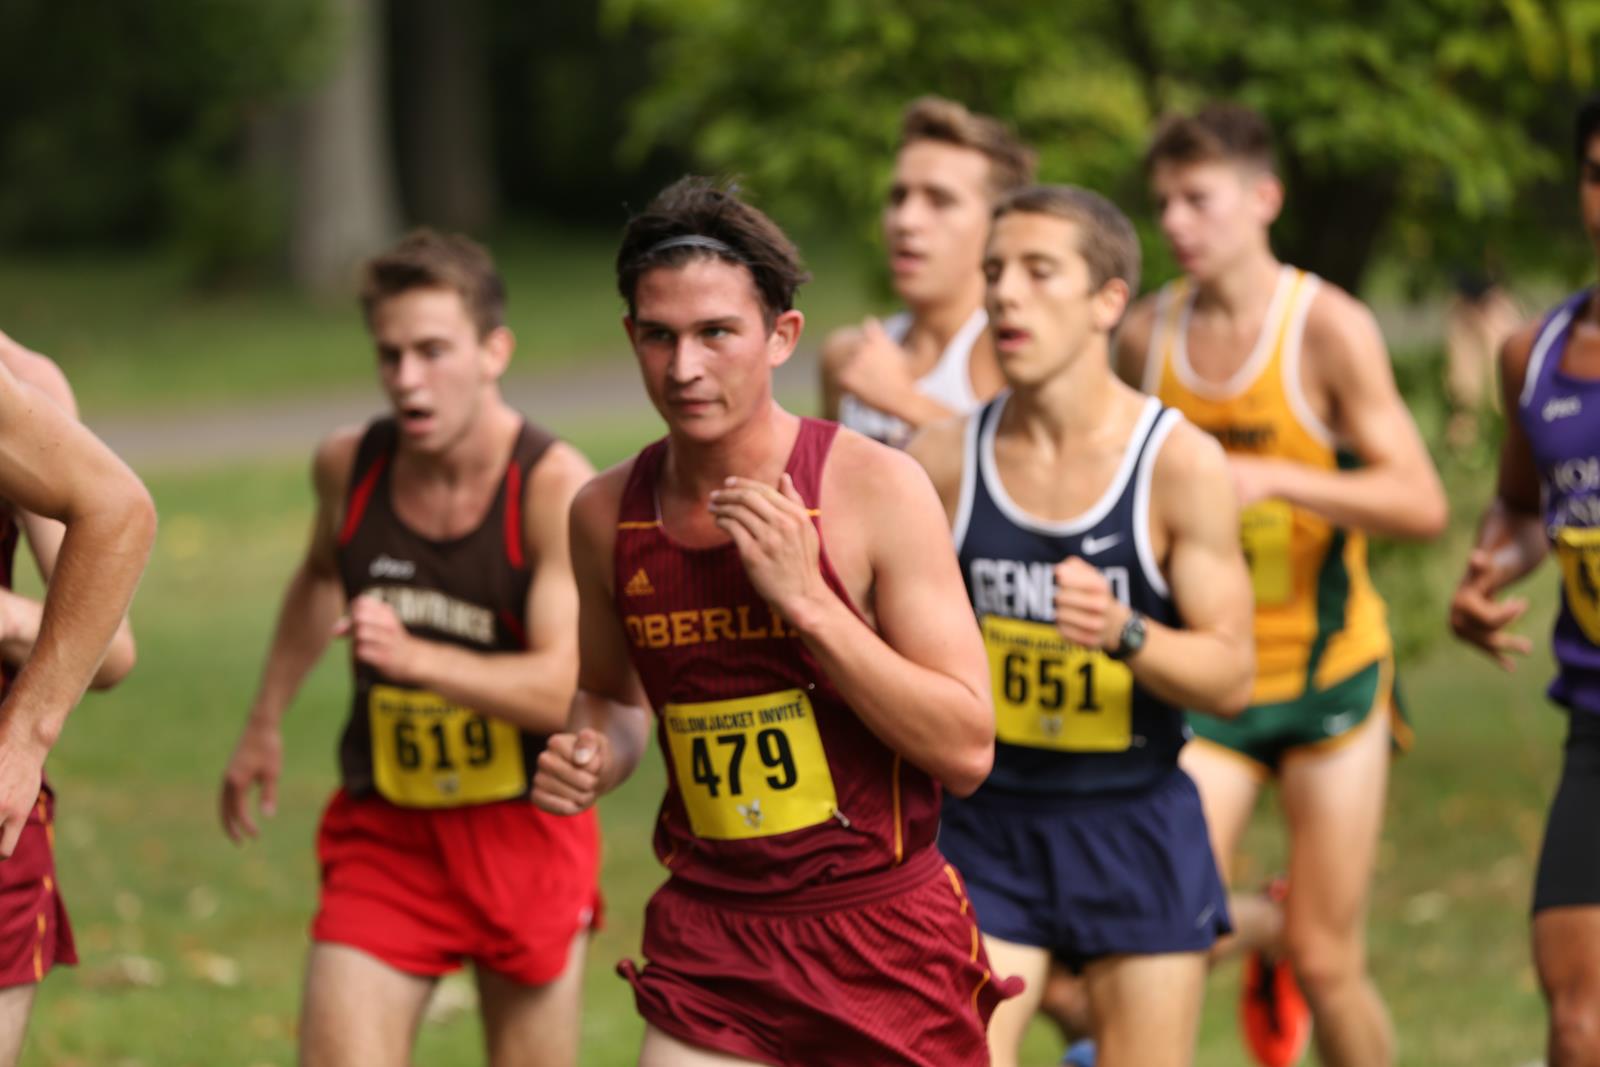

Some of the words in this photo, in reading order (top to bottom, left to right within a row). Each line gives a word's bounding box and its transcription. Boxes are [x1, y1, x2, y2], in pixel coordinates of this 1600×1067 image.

[625, 606, 801, 649] OBERLI
[1002, 650, 1102, 714] 651
[758, 702, 807, 724] INVITE
[394, 718, 494, 773] 619
[692, 728, 797, 797] 479
